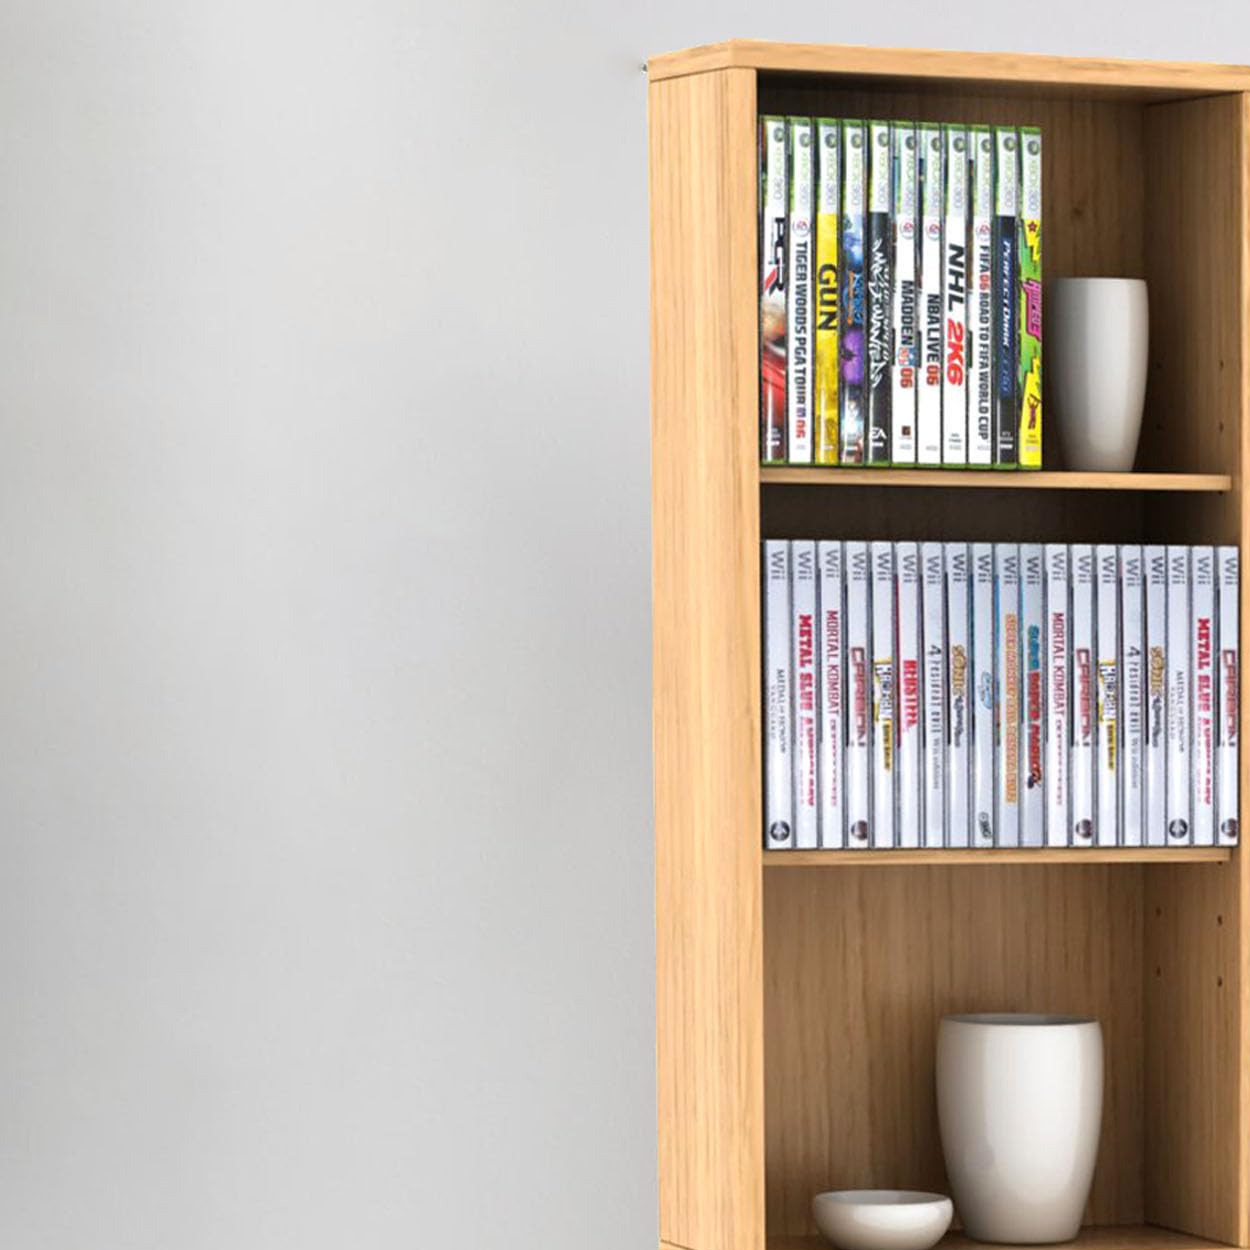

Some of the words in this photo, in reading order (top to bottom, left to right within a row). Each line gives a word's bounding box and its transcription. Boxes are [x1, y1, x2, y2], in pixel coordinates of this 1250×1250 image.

[796, 242, 808, 281] TIGER
[980, 246, 988, 272] FIFA
[948, 244, 963, 312] NHL
[980, 274, 987, 290] 06
[795, 284, 807, 334] WOODS
[818, 264, 837, 330] GUN
[928, 294, 940, 326] NBA
[979, 293, 987, 323] ROAD
[901, 280, 912, 345] MADDEN
[928, 328, 940, 362] LIVE
[979, 327, 987, 341] TO
[794, 337, 806, 366] PGA
[948, 319, 963, 386] 2K6
[979, 344, 987, 369] FIFA
[901, 368, 912, 388] 06
[927, 365, 939, 385] 06
[979, 372, 987, 414] WORLD
[978, 416, 988, 440] CUP
[771, 551, 784, 579] Wii
[798, 551, 811, 579] Wii
[852, 553, 864, 580] Wii
[877, 553, 891, 580] Wii
[927, 557, 940, 584] Wii
[952, 554, 965, 582] Wii
[1004, 557, 1016, 585] Wii
[1027, 557, 1039, 585] Wii
[1078, 555, 1091, 583] Wii
[1102, 556, 1115, 583] Wii
[1151, 557, 1164, 584] Wii
[1172, 557, 1184, 584] Wii
[1225, 557, 1236, 585] Wii
[799, 615, 812, 667] METAL
[827, 611, 838, 661] MORTAL
[1053, 613, 1064, 662] MORTAL
[1198, 618, 1210, 669] METAL
[928, 645, 940, 656] 4
[799, 673, 812, 710] SLUG
[827, 665, 838, 716] KOMBAT
[1053, 666, 1064, 716] KOMBAT
